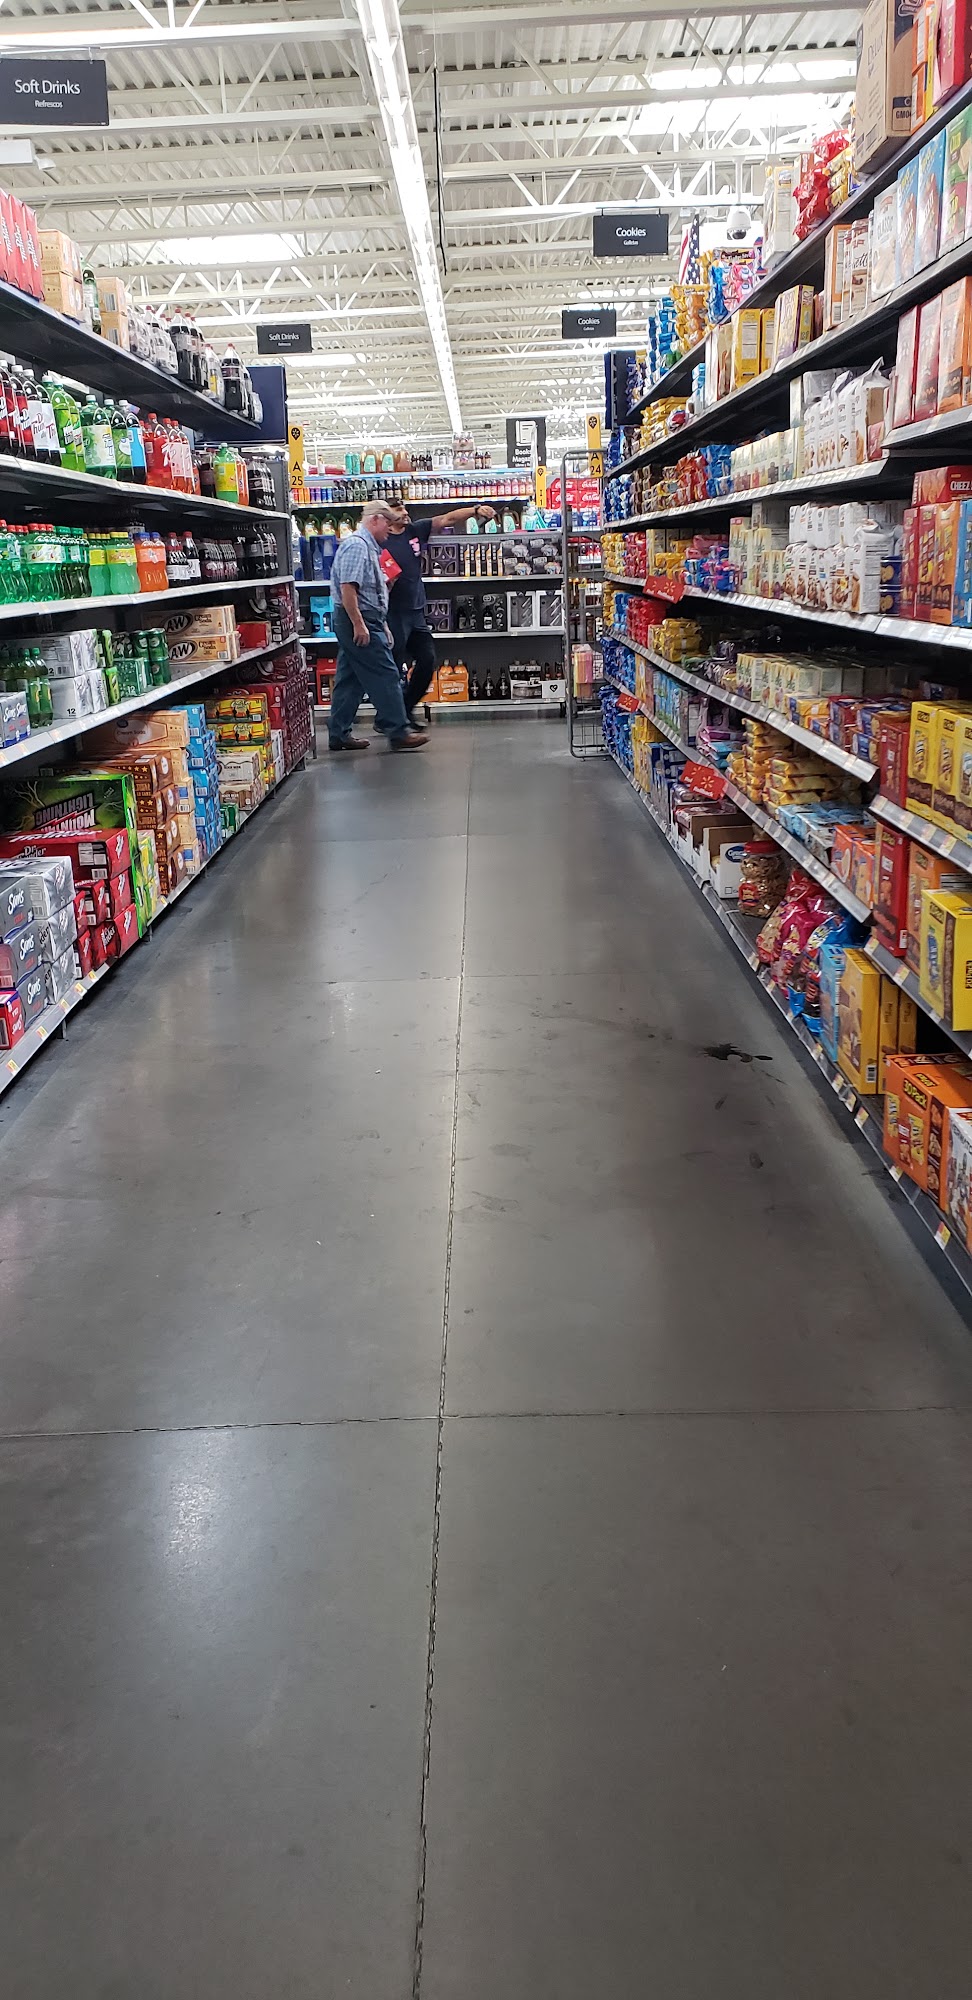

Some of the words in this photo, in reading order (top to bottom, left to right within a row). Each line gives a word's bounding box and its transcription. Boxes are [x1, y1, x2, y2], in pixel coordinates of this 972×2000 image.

[14, 79, 40, 94] Soft
[42, 79, 81, 95] Drinks
[34, 100, 63, 108] Refrescos
[616, 227, 647, 237] Cookies
[577, 317, 601, 325] Cookies
[269, 333, 281, 341] Soft
[281, 332, 300, 340] Drinks
[591, 452, 599, 461] A
[292, 461, 302, 472] A
[590, 464, 601, 475] 24
[291, 475, 303, 486] 25
